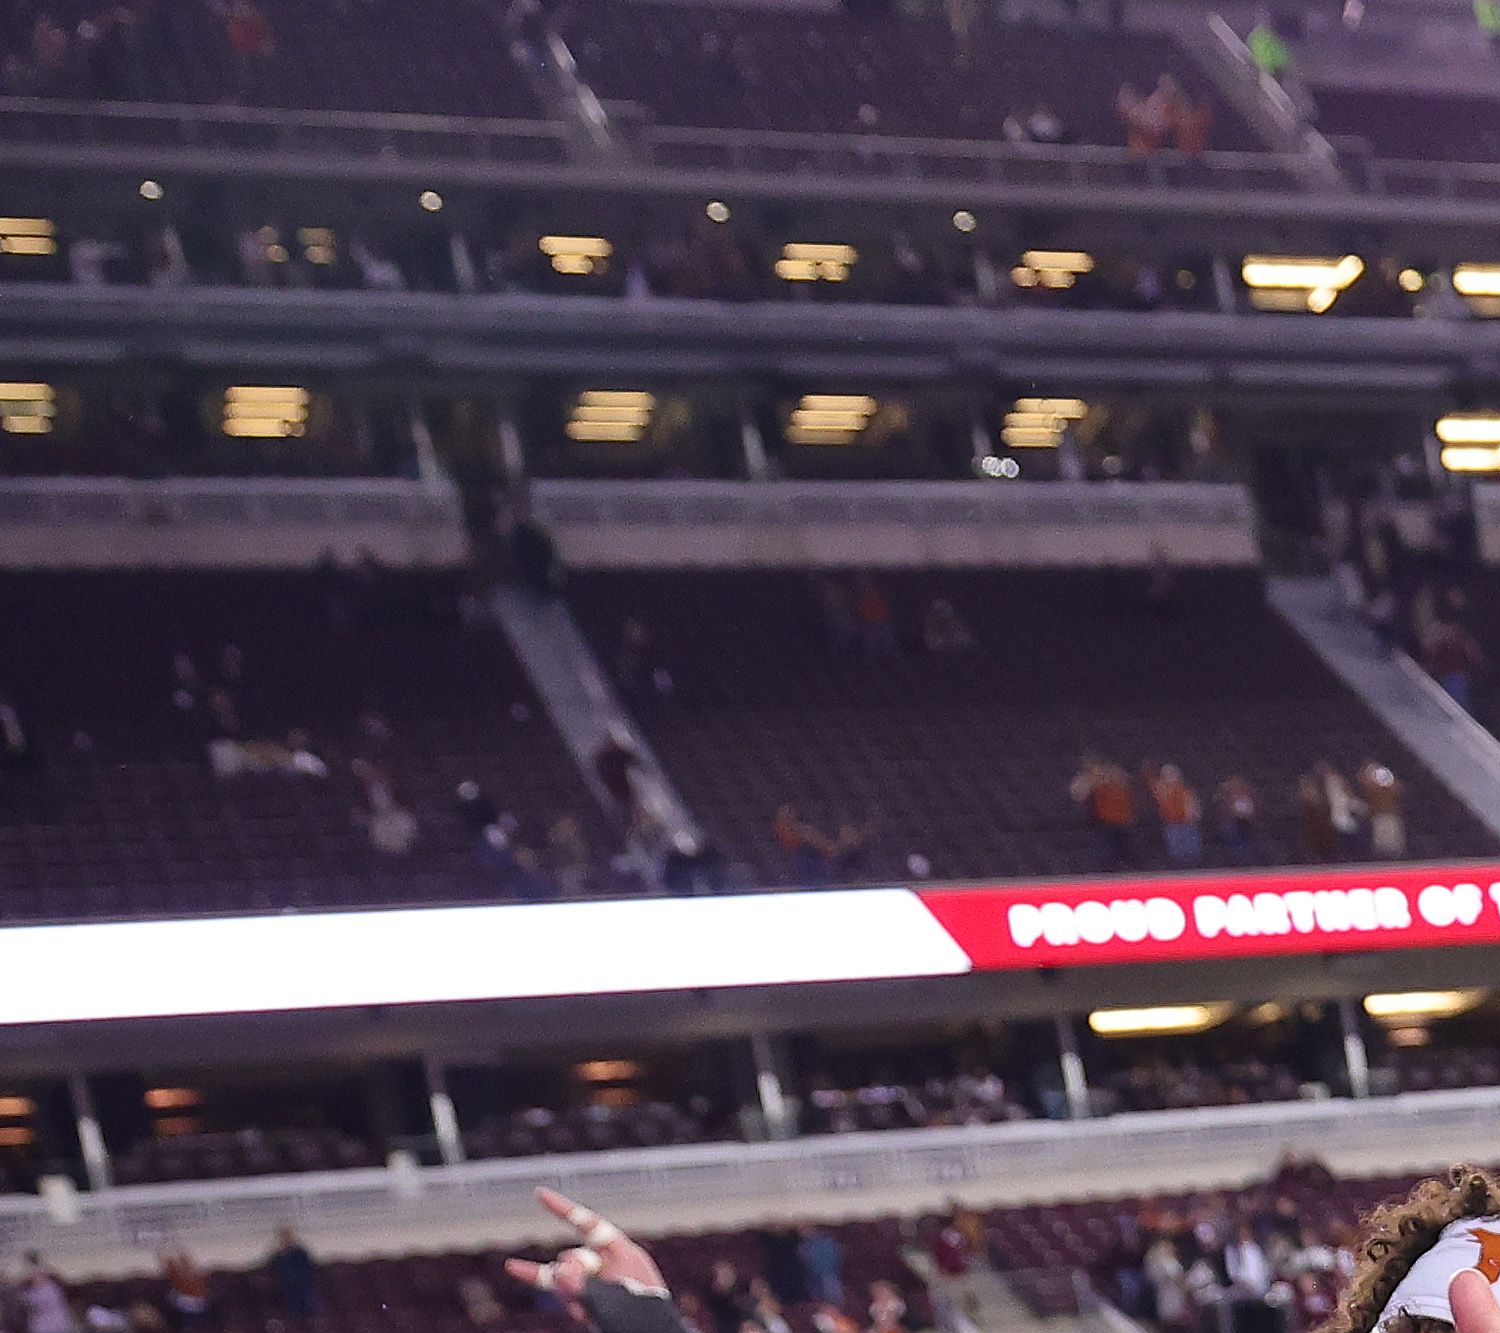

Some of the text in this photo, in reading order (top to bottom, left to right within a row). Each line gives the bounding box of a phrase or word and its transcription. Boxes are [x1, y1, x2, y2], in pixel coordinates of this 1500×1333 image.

[1008, 897, 1186, 947] PROUD
[1193, 887, 1411, 938] PARTNER
[1418, 883, 1483, 926] OF
